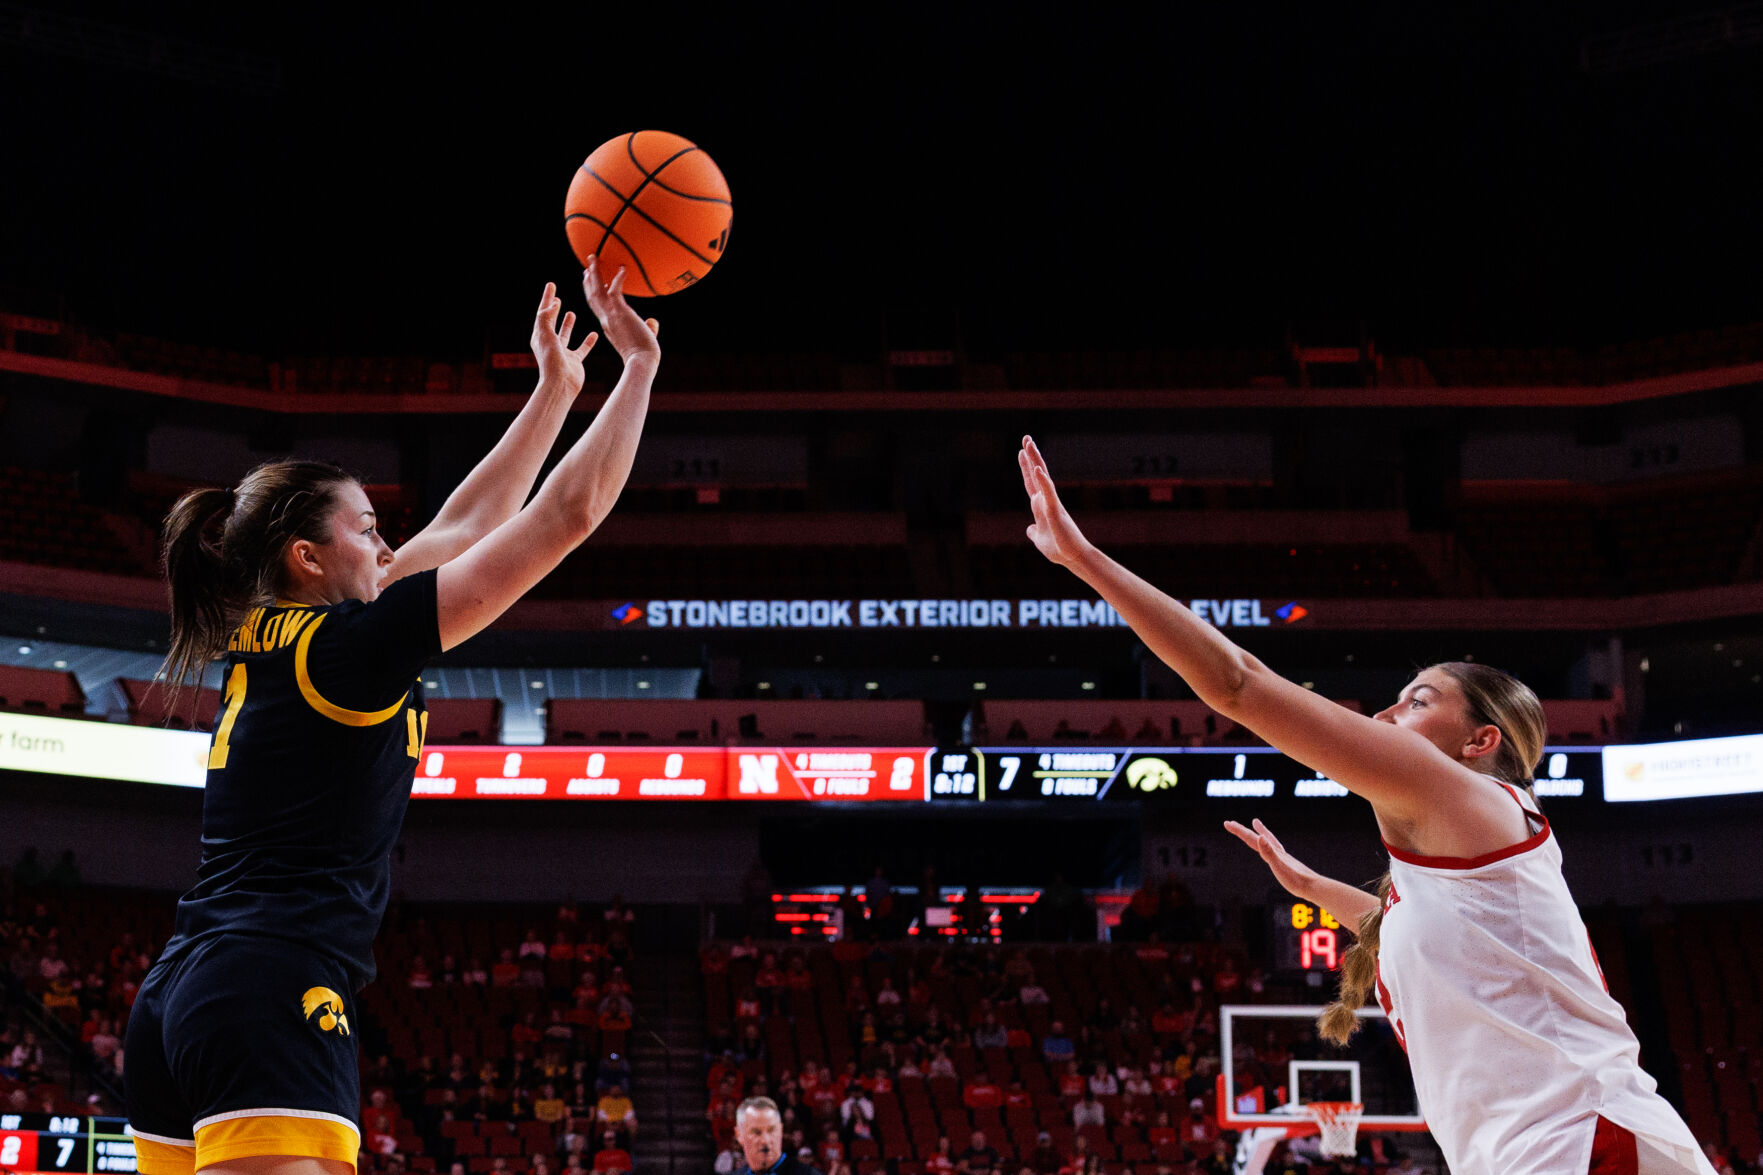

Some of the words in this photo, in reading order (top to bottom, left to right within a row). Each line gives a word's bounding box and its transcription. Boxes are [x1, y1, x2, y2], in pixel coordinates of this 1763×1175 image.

[1133, 455, 1178, 474] 212
[646, 600, 853, 628] STONEBROOK
[859, 600, 1011, 628] EXTERIOR
[1189, 600, 1270, 627] EVEL
[208, 663, 247, 770] 1
[11, 731, 65, 753] farm
[425, 752, 443, 777] 0
[503, 753, 522, 777] 2
[586, 754, 605, 777] 0
[664, 754, 683, 777] 0
[739, 754, 779, 794] N
[890, 756, 914, 790] 2
[1000, 757, 1020, 790] 7
[1234, 754, 1246, 779] 1
[1548, 754, 1568, 779] 0
[1158, 847, 1208, 867] 112
[1301, 928, 1336, 969] 19
[0, 1135, 22, 1166] 2
[55, 1138, 76, 1168] 7
